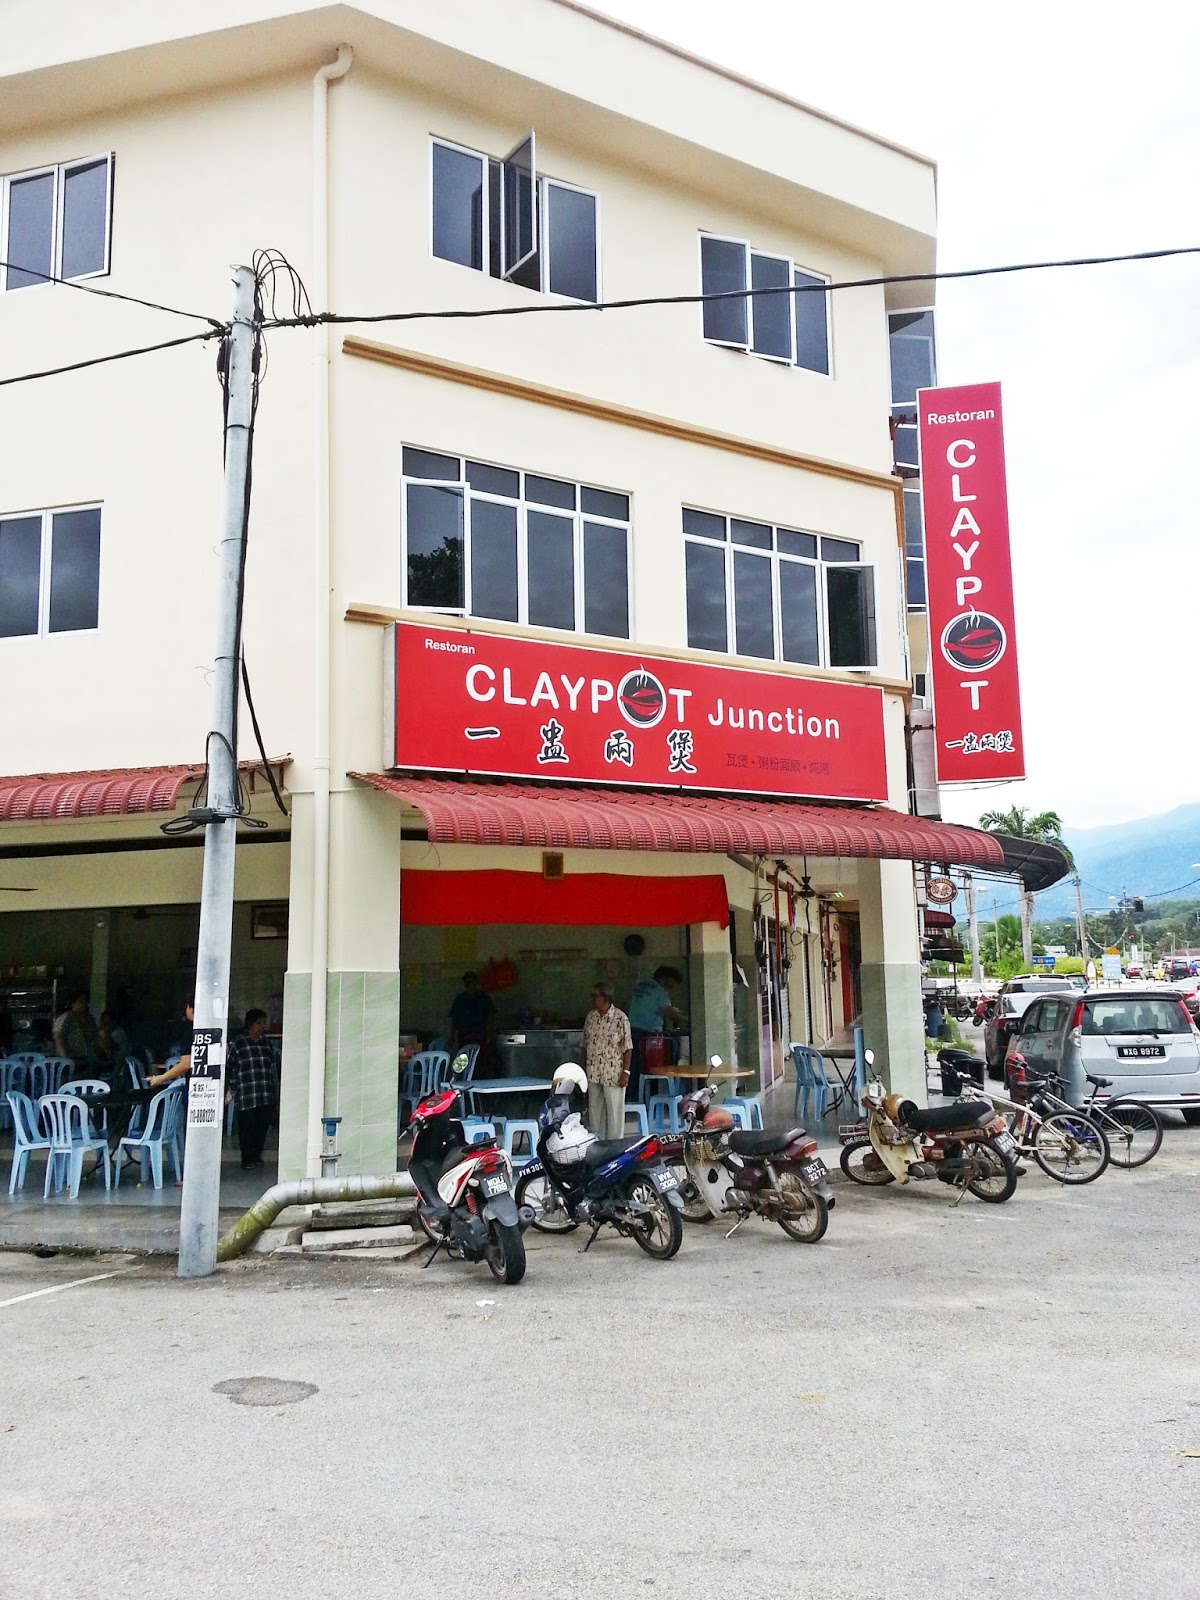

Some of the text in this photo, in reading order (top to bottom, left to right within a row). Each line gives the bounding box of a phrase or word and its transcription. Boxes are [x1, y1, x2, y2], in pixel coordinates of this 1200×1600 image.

[927, 407, 996, 426] Restoran
[424, 637, 476, 655] Restoran
[707, 698, 840, 739] Junction
[192, 1033, 212, 1045] JBS
[1123, 1047, 1139, 1056] WXG
[806, 1161, 819, 1173] BCT
[808, 1167, 827, 1181] 3272
